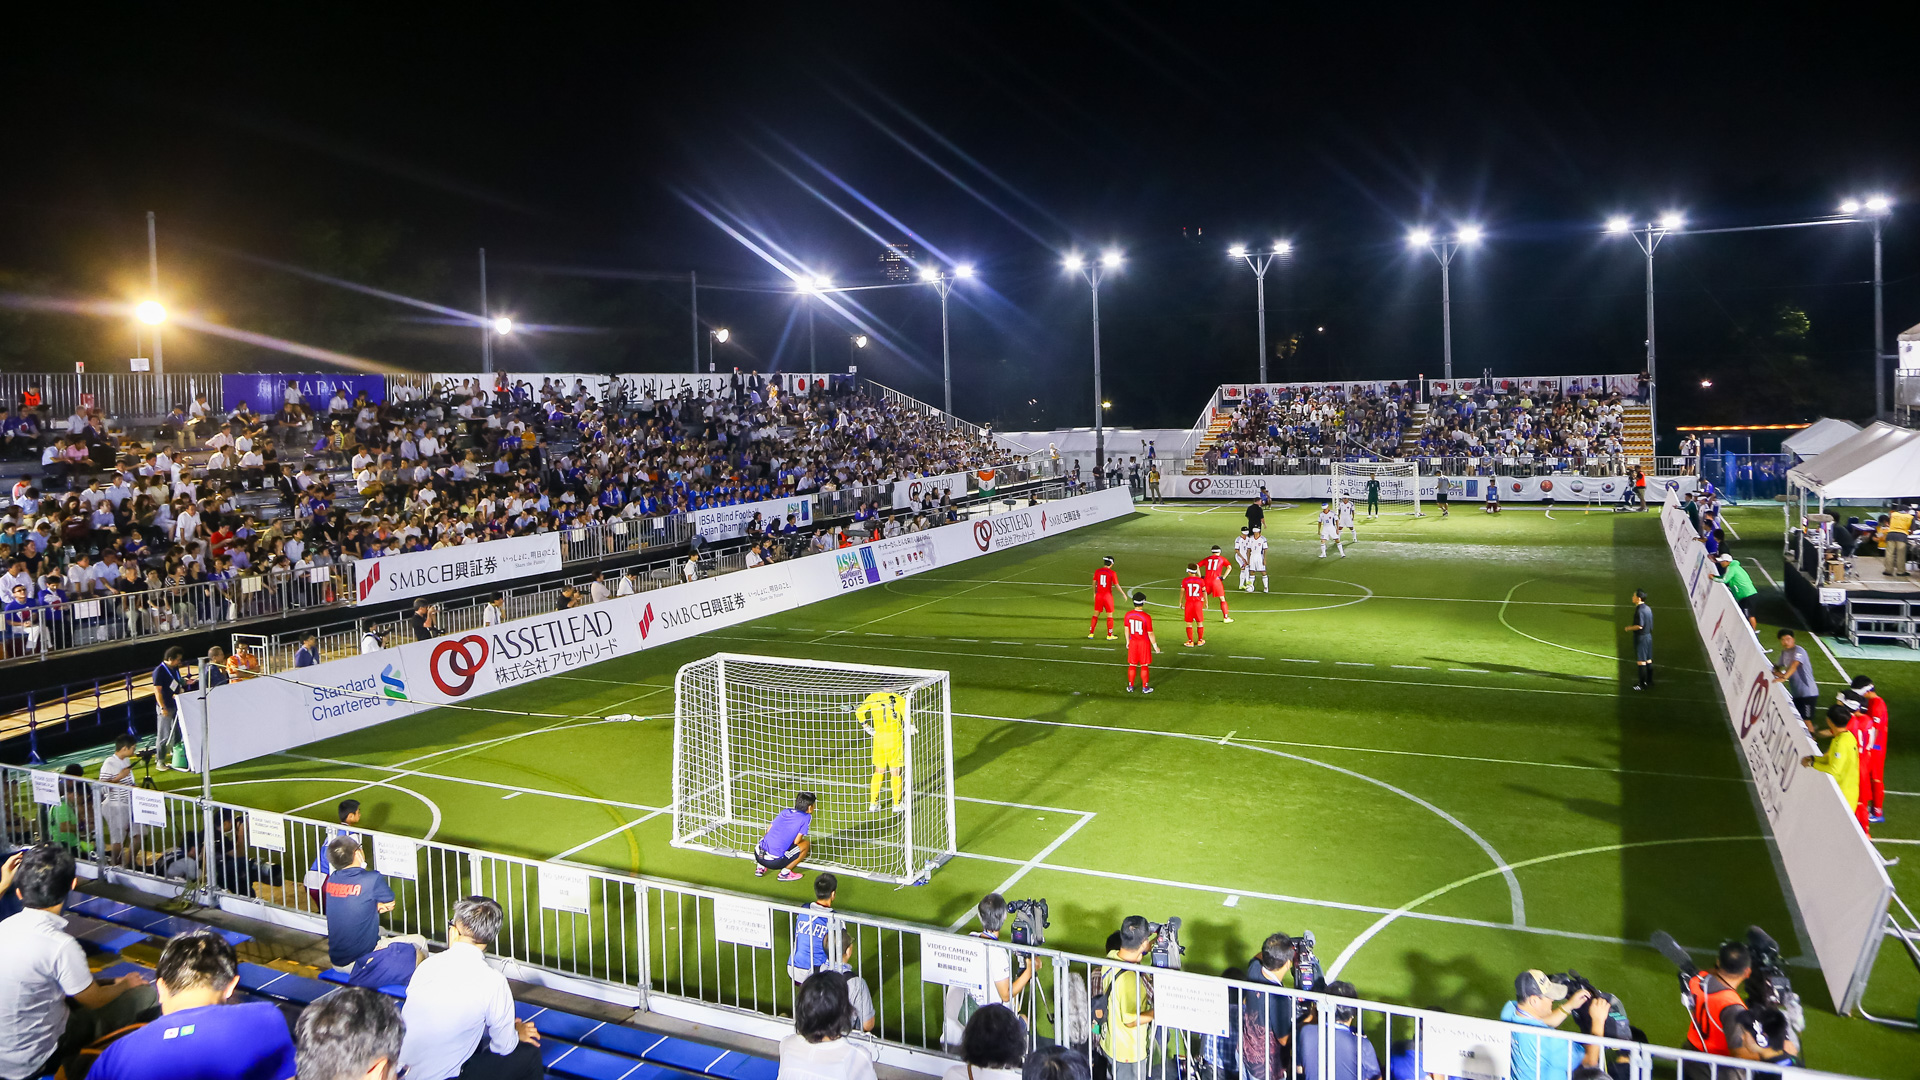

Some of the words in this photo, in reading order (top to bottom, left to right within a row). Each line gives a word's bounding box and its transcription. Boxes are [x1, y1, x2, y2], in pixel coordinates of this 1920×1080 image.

[296, 380, 353, 396] JAPAN
[923, 478, 953, 492] ASSETLEAD
[1210, 479, 1266, 489] ASSETLEAD
[1449, 480, 1462, 488] SIA
[1420, 488, 1434, 496] 015
[699, 514, 715, 525] IBSA
[717, 511, 733, 522] Blind
[992, 512, 1033, 536] ASSETLEAD
[700, 526, 718, 536] Asian
[836, 551, 861, 575] ASIA
[1207, 559, 1219, 570] 11
[389, 556, 498, 592] SMBC日興証券
[842, 575, 865, 589] 2015
[1100, 575, 1107, 588] 4
[1187, 583, 1200, 597] 12
[661, 592, 746, 629] SMBC日興証券
[1129, 619, 1143, 635] 14
[492, 610, 613, 663] ASSETLEAD
[495, 638, 618, 685] 株式会社アセットリード
[312, 675, 377, 701] Standard
[312, 692, 380, 721] Chartered
[555, 874, 584, 885] SMOKING
[796, 920, 828, 939] STAFF
[927, 942, 947, 951] VIDEO
[948, 947, 978, 957] CAMERAS
[934, 951, 971, 963] FORBIDDEN
[1160, 984, 1183, 992] PLEASE
[1431, 1025, 1446, 1034] NO
[1450, 1029, 1504, 1043] SMOKING
